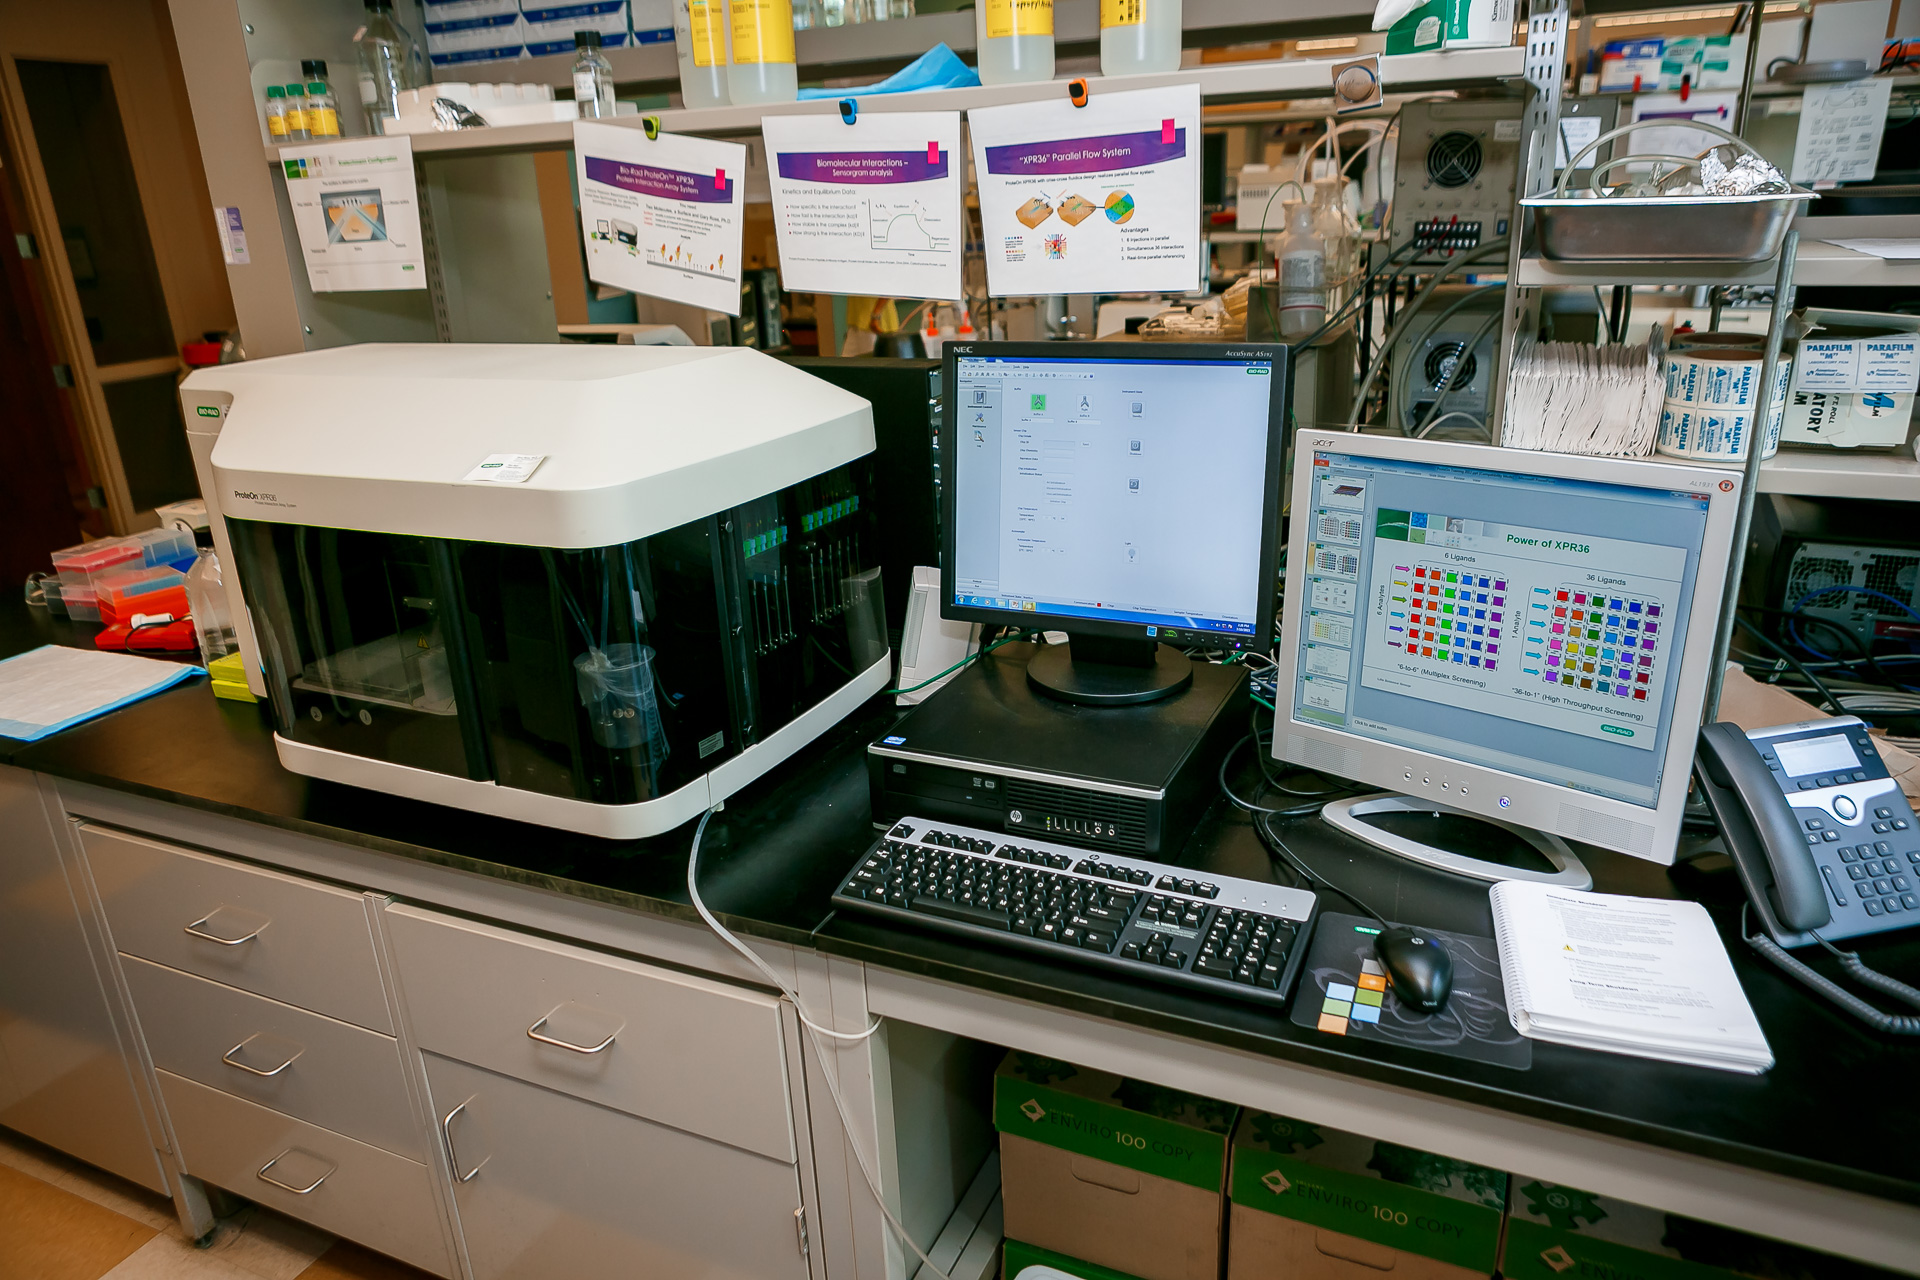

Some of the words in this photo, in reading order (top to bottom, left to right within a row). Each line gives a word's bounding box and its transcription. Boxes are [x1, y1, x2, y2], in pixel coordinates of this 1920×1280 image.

[816, 158, 861, 168] Biomolecular
[862, 158, 903, 168] Interactions
[1019, 154, 1051, 165] "XPR36"
[1052, 151, 1082, 162] Parallel
[1082, 150, 1101, 160] Flow
[1102, 147, 1131, 158] System
[676, 175, 695, 186] XPR36
[832, 168, 868, 178] Sensorgram
[868, 169, 894, 178] analysis
[616, 174, 633, 184] Protein
[634, 176, 664, 188] Interaction
[664, 182, 679, 192] Array
[680, 185, 699, 195] System
[1806, 344, 1852, 352] PARAFILM
[1867, 344, 1914, 352] PARAFILM
[1685, 364, 1698, 402] PARAFILM
[1738, 366, 1752, 405] PARAFILM
[198, 407, 220, 416] BIO-RAD
[1806, 392, 1827, 434] ATORY
[1828, 406, 1838, 424] ROLL
[1678, 413, 1690, 450] PARAFILM
[1730, 416, 1744, 454] PARAFILM
[1312, 438, 1336, 447] acer
[234, 490, 258, 500] ProteOn
[1506, 533, 1538, 548] Power
[1540, 537, 1552, 550] of
[1554, 540, 1590, 554] XPR36
[1450, 554, 1476, 564] Ligands
[1596, 574, 1626, 586] Ligands
[1377, 584, 1386, 610] Analytes
[1512, 610, 1521, 634] Analyte
[1397, 663, 1420, 673] "6-to-6"
[1420, 668, 1450, 681] (Multiplex
[1451, 673, 1486, 689] Screening)
[1512, 687, 1541, 698] "36-to-1"
[1542, 692, 1560, 704] (High
[1562, 698, 1603, 714] Throughput
[1604, 706, 1644, 722] Screening)
[1603, 726, 1632, 736] BIO-RAD
[1115, 1131, 1146, 1150] 100
[1152, 1141, 1194, 1161] COPY
[1372, 1205, 1408, 1226] 100
[1415, 1216, 1464, 1239] COPY
